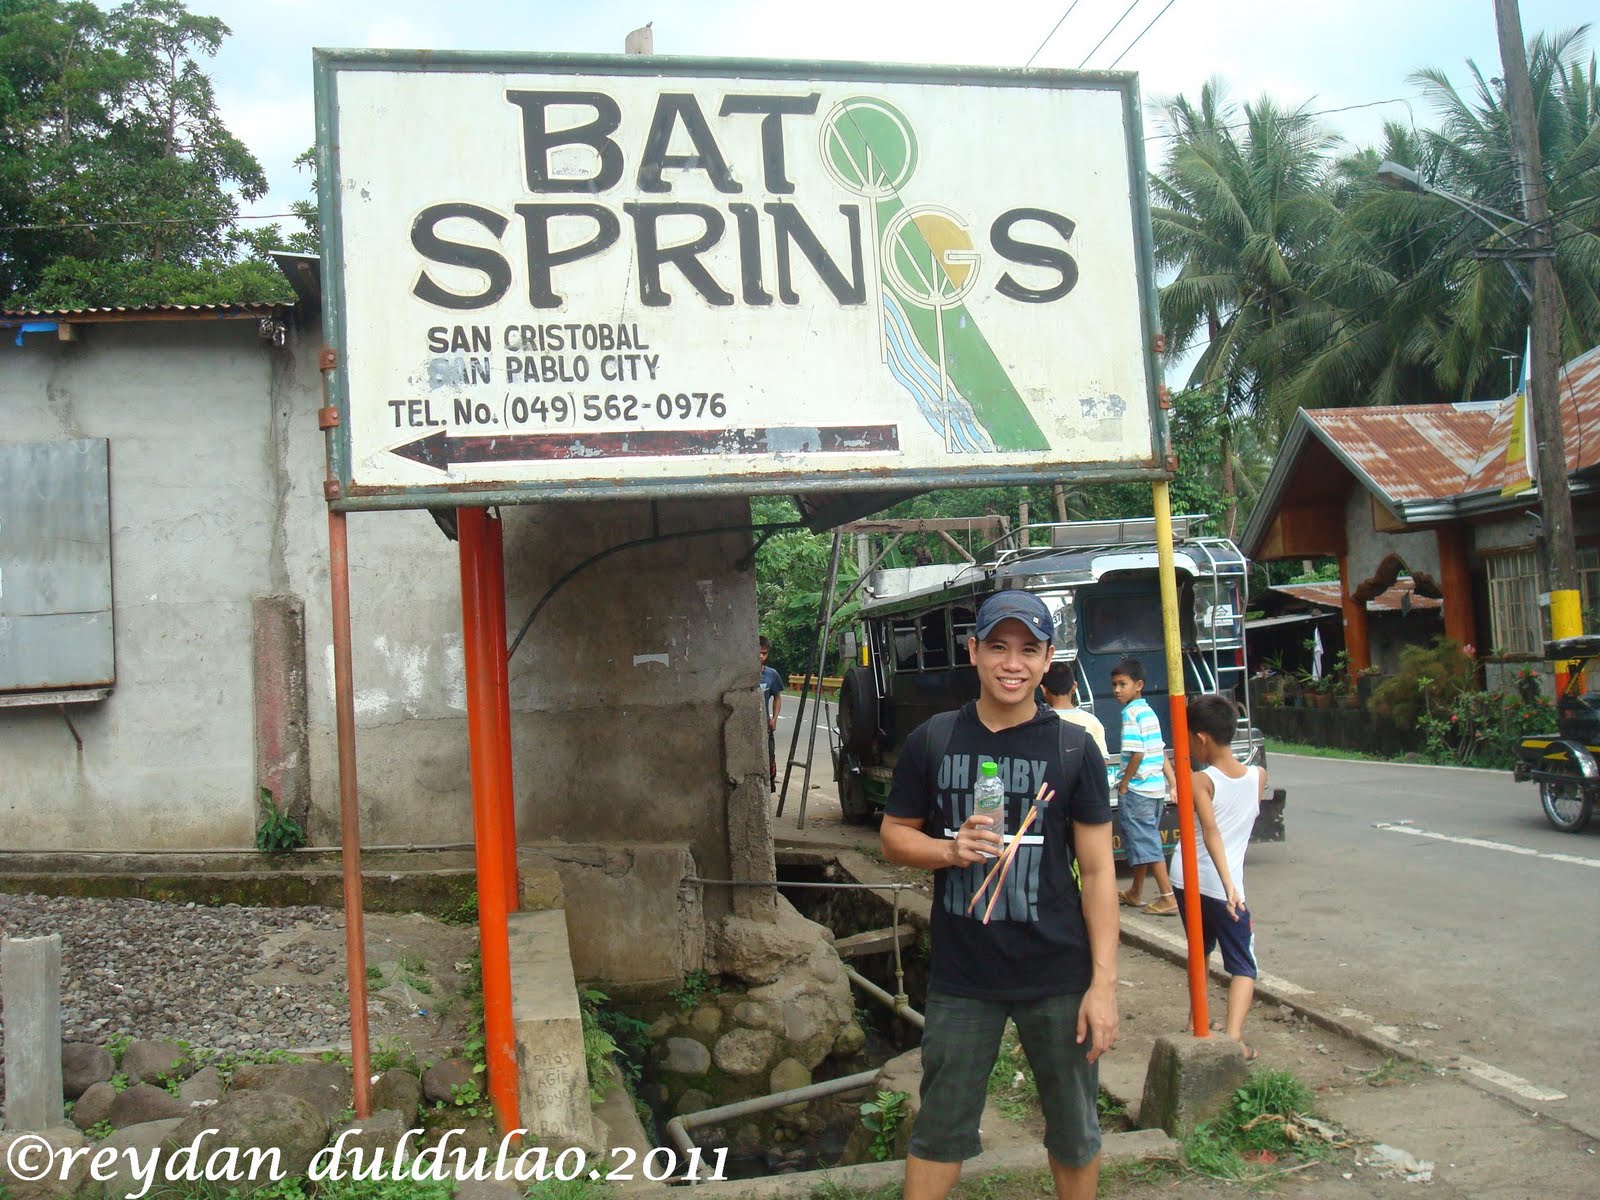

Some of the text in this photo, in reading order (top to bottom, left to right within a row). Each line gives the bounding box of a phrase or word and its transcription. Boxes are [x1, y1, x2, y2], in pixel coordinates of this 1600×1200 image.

[505, 88, 918, 202] BATO
[410, 201, 1079, 310] SPRINGS
[427, 323, 649, 353] SAN CRISTOBAL
[506, 355, 590, 383] PABLO
[601, 354, 660, 382] CITY
[388, 391, 727, 430] TEL. No. (049) 562-0976
[937, 754, 970, 790] OH
